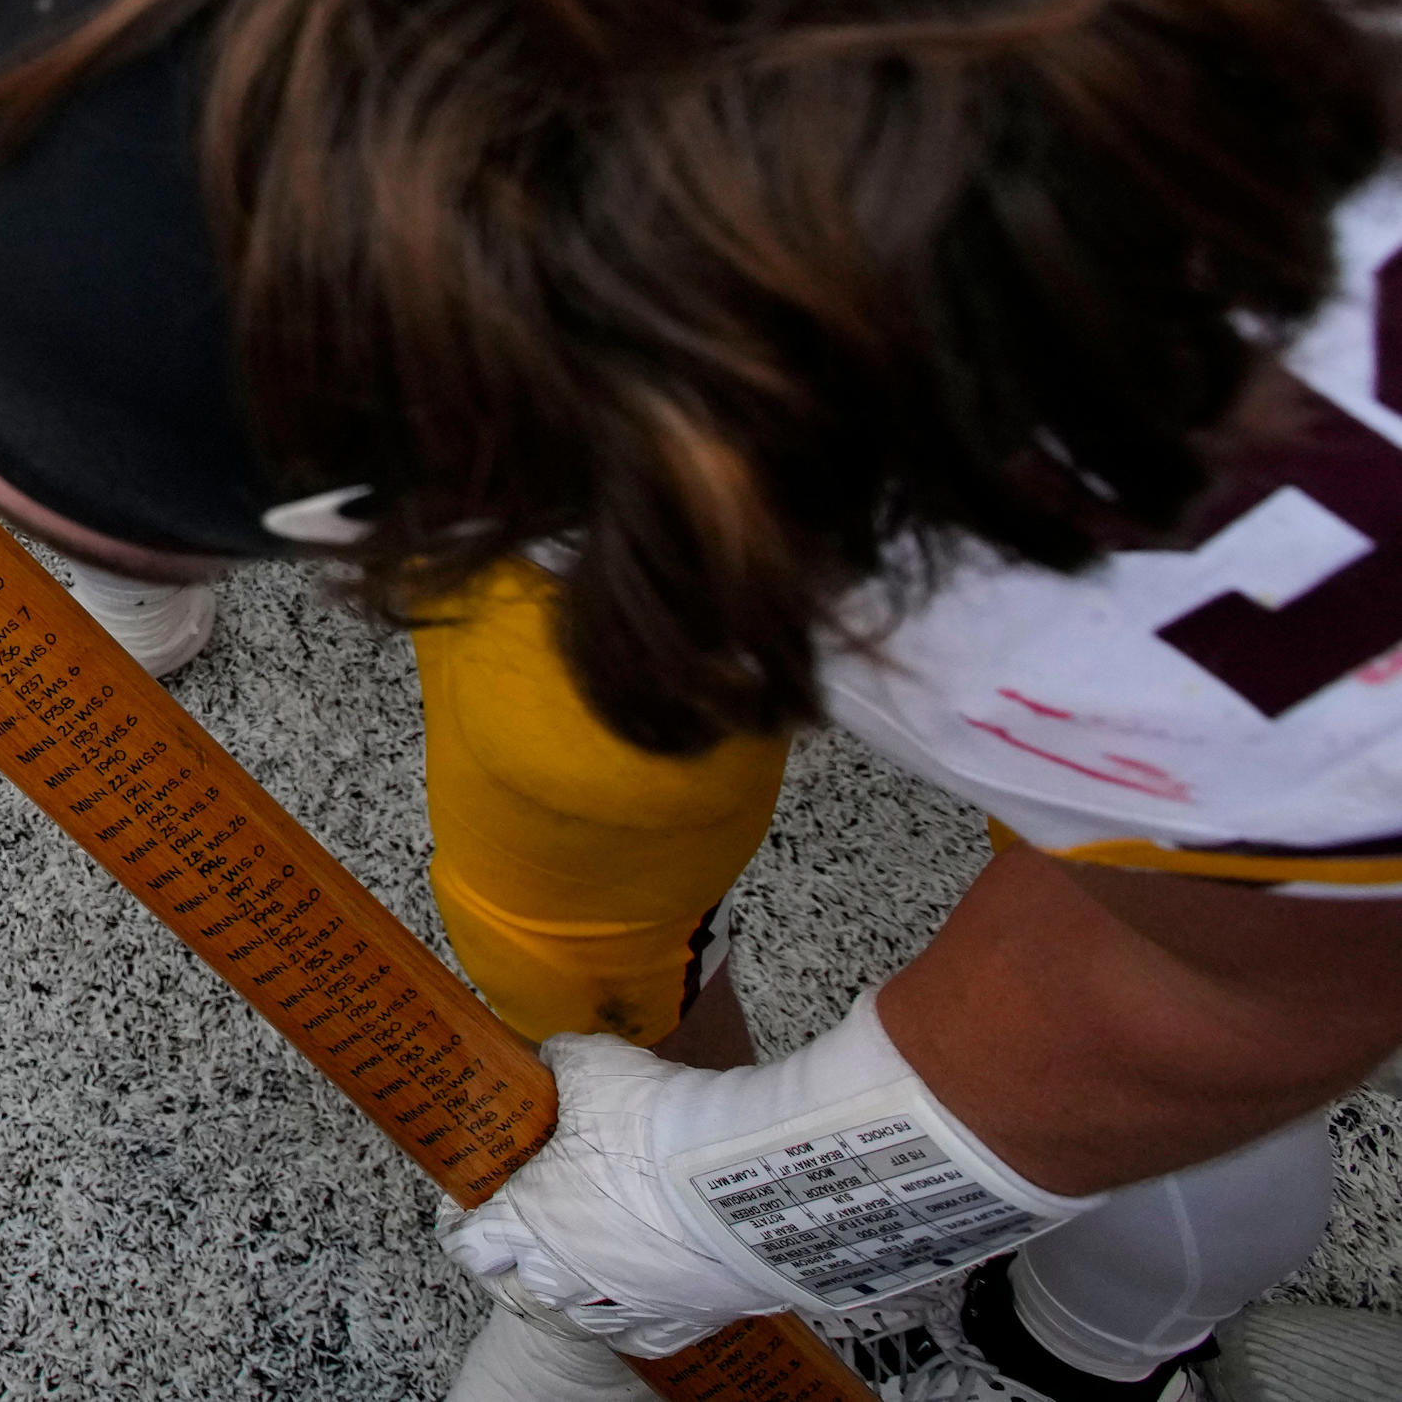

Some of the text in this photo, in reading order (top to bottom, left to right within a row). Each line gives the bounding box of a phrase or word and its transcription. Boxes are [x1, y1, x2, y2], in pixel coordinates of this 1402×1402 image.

[13, 672, 45, 701] 1937
[69, 721, 101, 750] 1939
[15, 732, 60, 766] MINN.
[199, 905, 244, 940] MINN.
[272, 924, 309, 952] 1952
[857, 1124, 895, 1143] CHOICE
[784, 1141, 813, 1157] MOON
[707, 1167, 758, 1190] FLAME MATT
[805, 1167, 835, 1182] MOON
[831, 1192, 853, 1205] SUN
[748, 1212, 785, 1228] ROTATE
